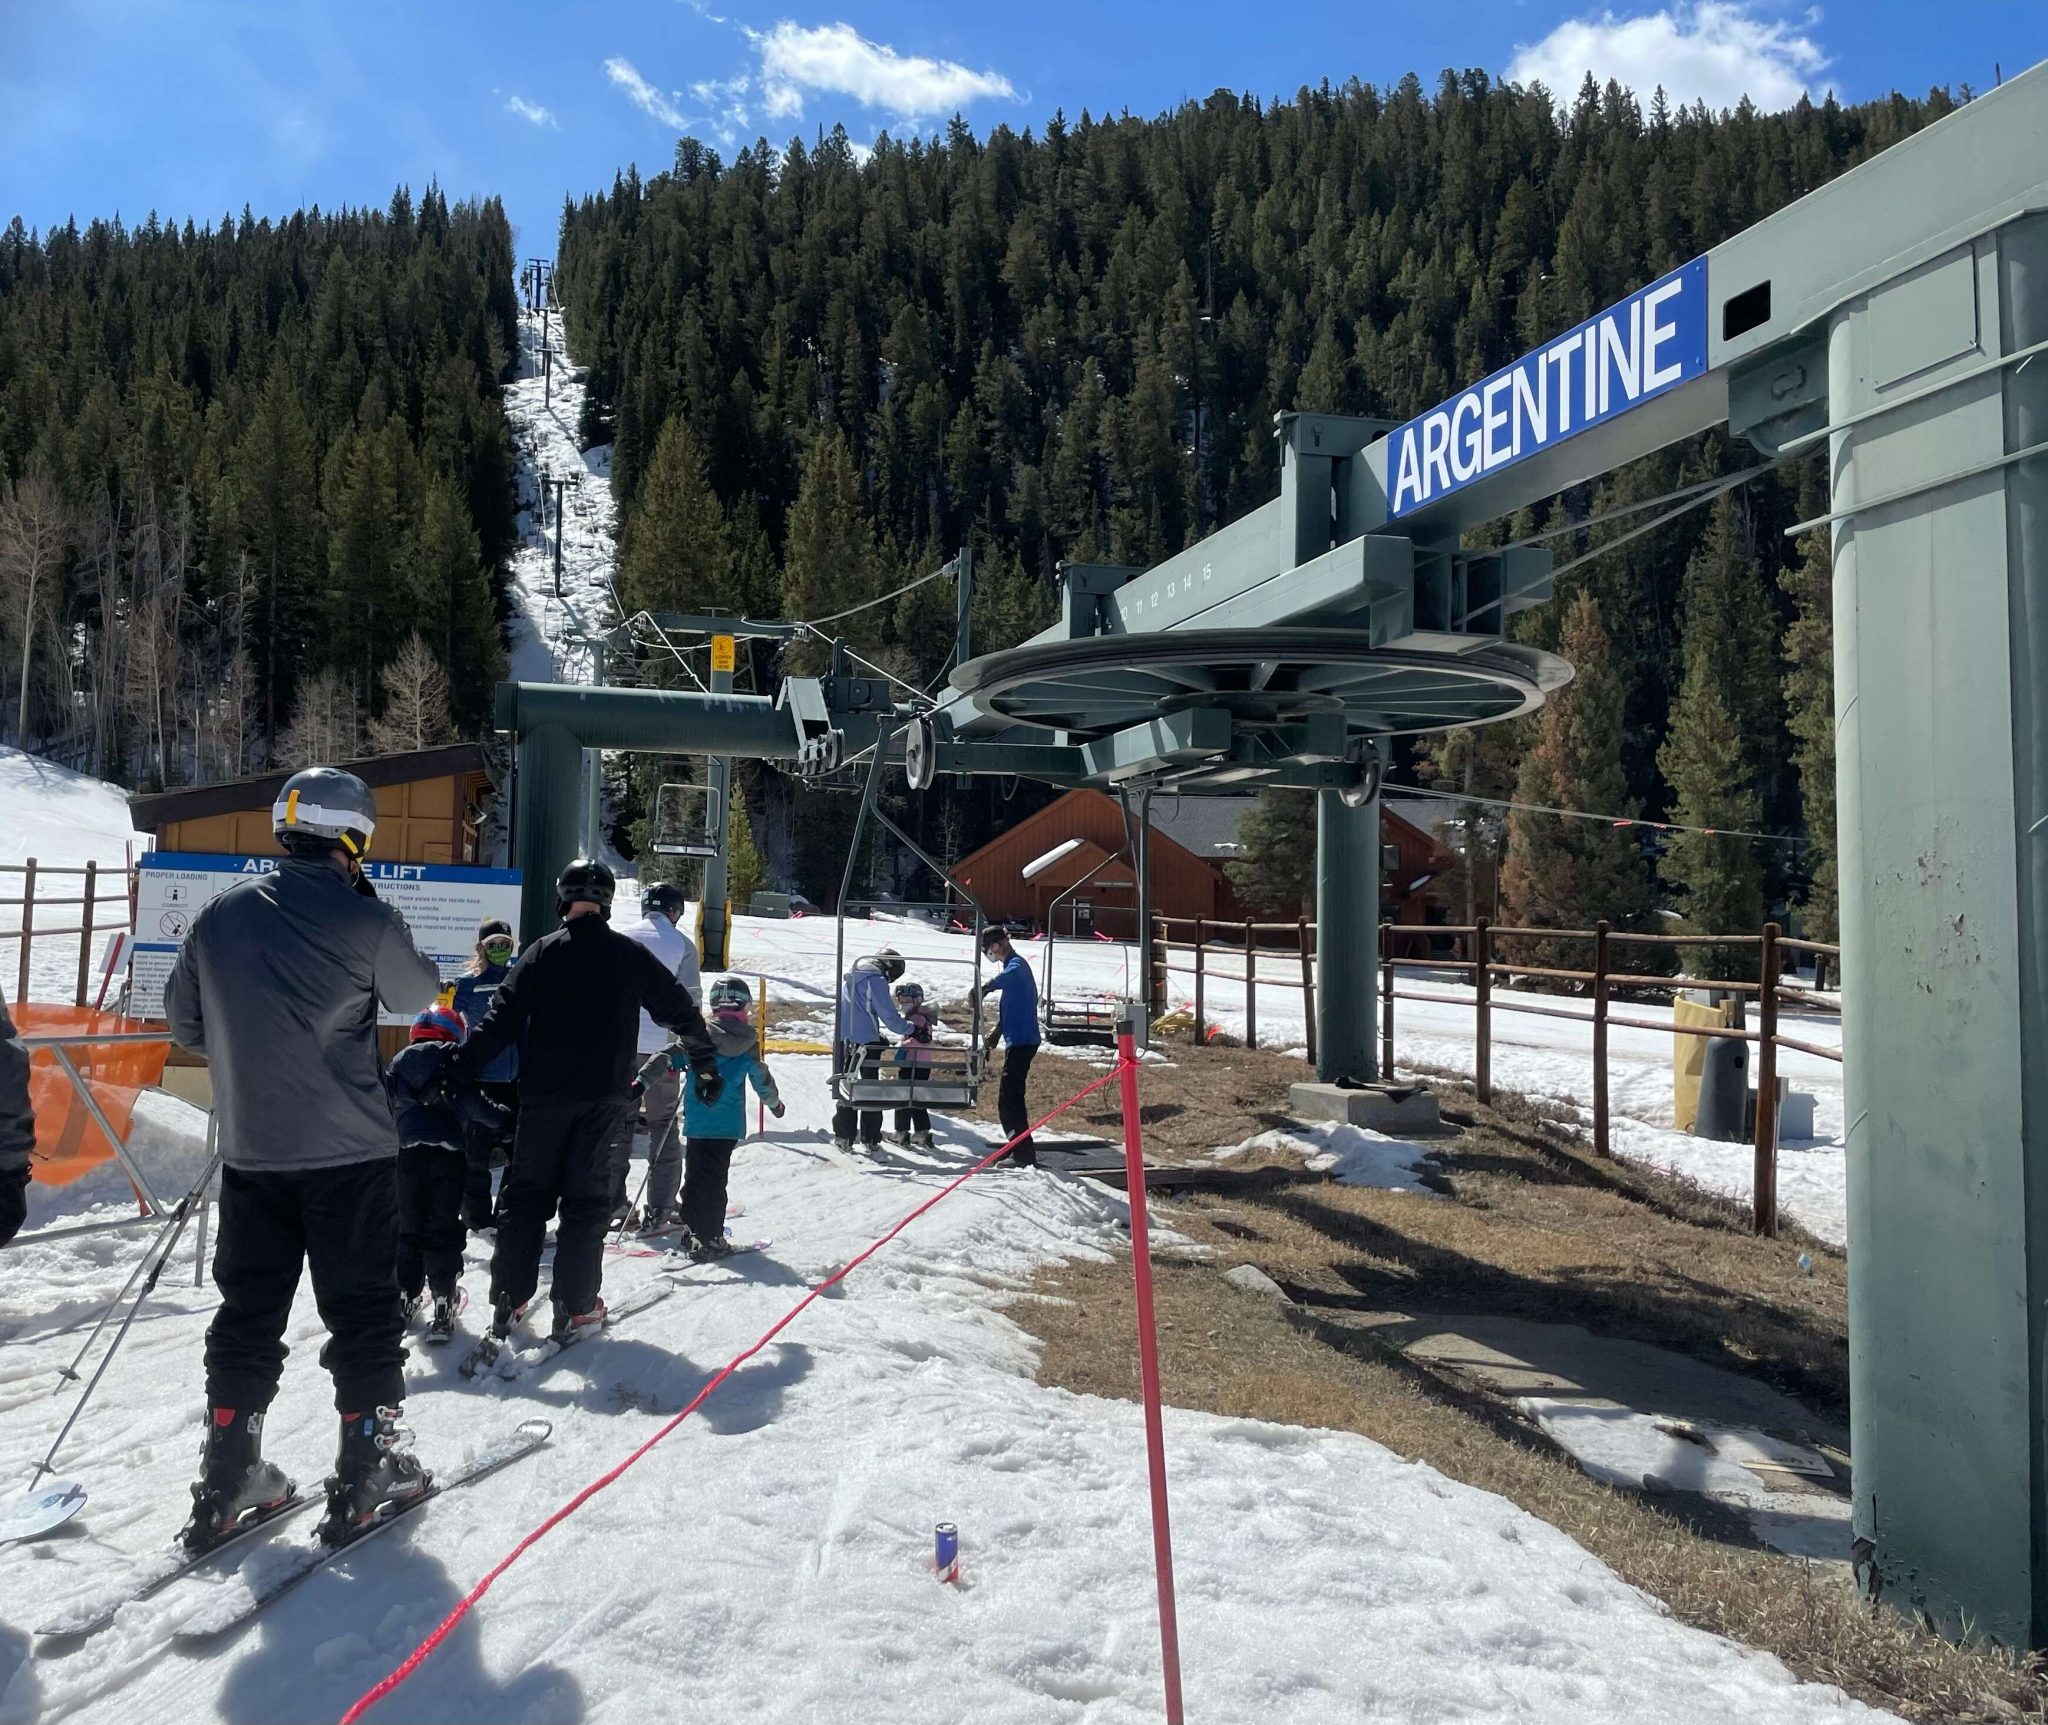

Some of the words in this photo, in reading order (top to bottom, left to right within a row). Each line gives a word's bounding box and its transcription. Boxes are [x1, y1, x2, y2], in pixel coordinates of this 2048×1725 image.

[1393, 277, 1682, 514] ARGENTINE
[1136, 599, 1143, 614] 11
[1150, 591, 1159, 608] 12
[1167, 582, 1175, 599] 13
[1183, 573, 1192, 591] 14
[1203, 563, 1212, 581] 15
[145, 871, 175, 879] PROPER
[176, 872, 208, 881] LOADING
[380, 864, 427, 880] LIFT
[374, 882, 421, 891] TRUCTIONS
